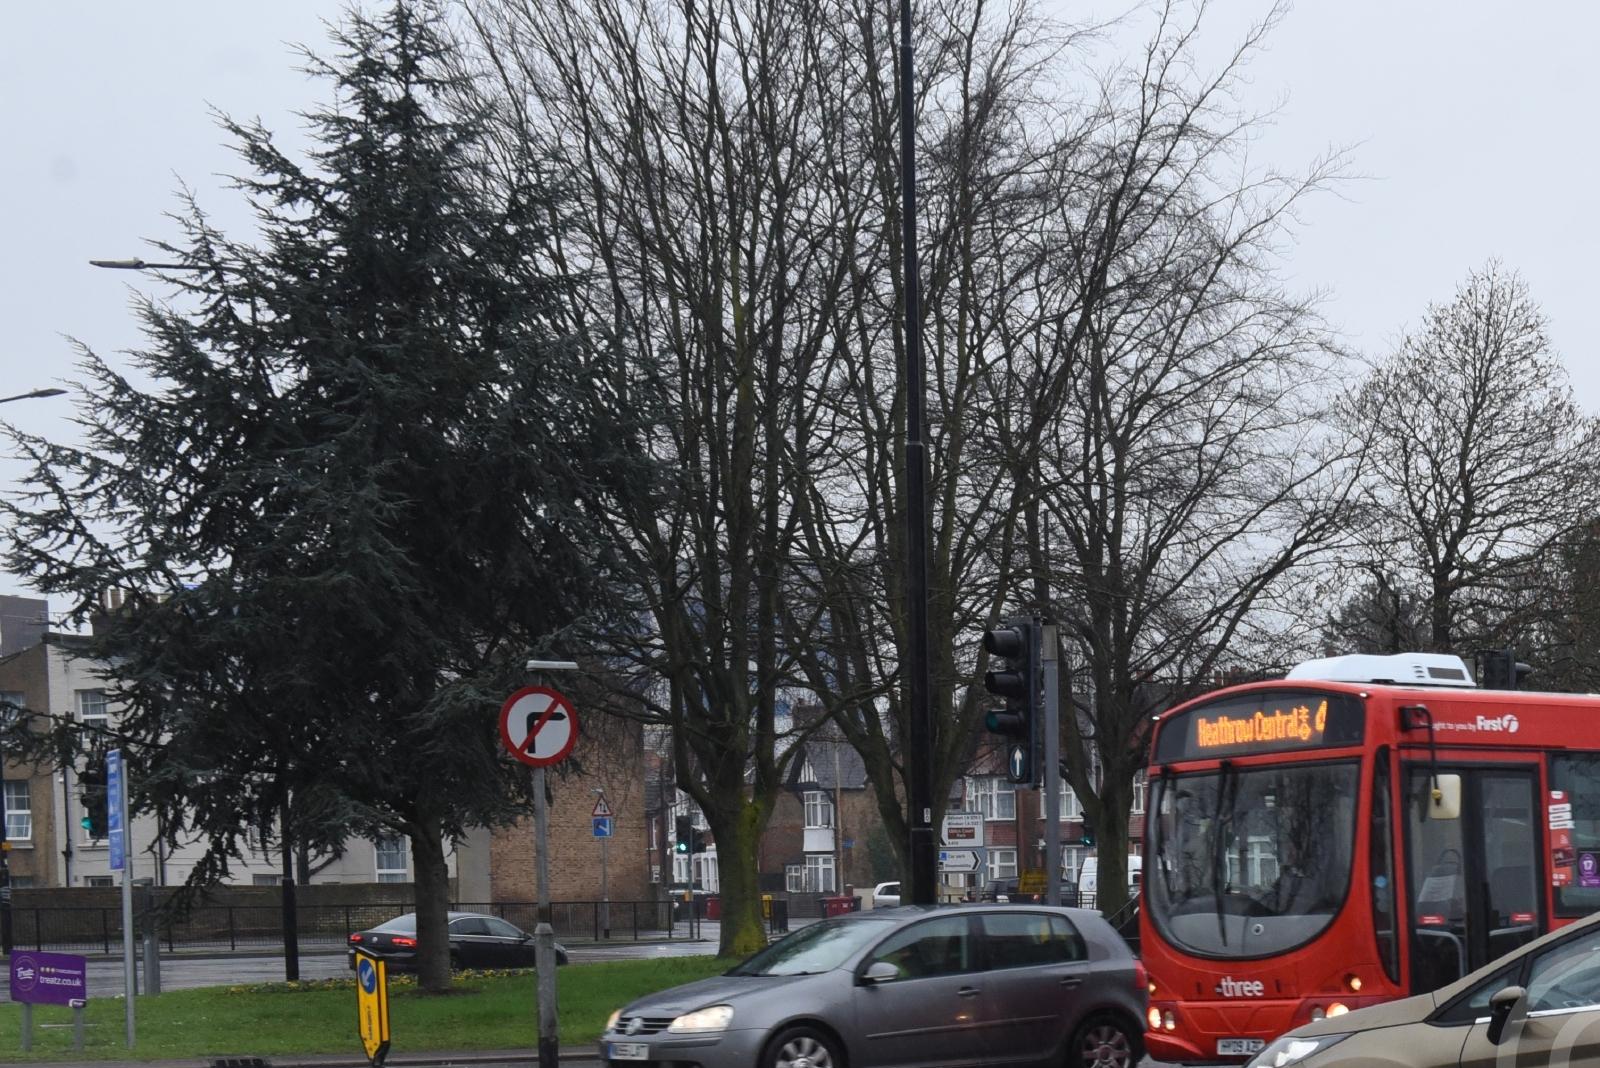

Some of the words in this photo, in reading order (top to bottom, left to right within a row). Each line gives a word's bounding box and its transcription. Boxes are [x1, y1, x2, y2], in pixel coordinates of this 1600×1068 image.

[1255, 706, 1299, 742] Central
[1475, 715, 1503, 732] First
[1221, 975, 1264, 997] three
